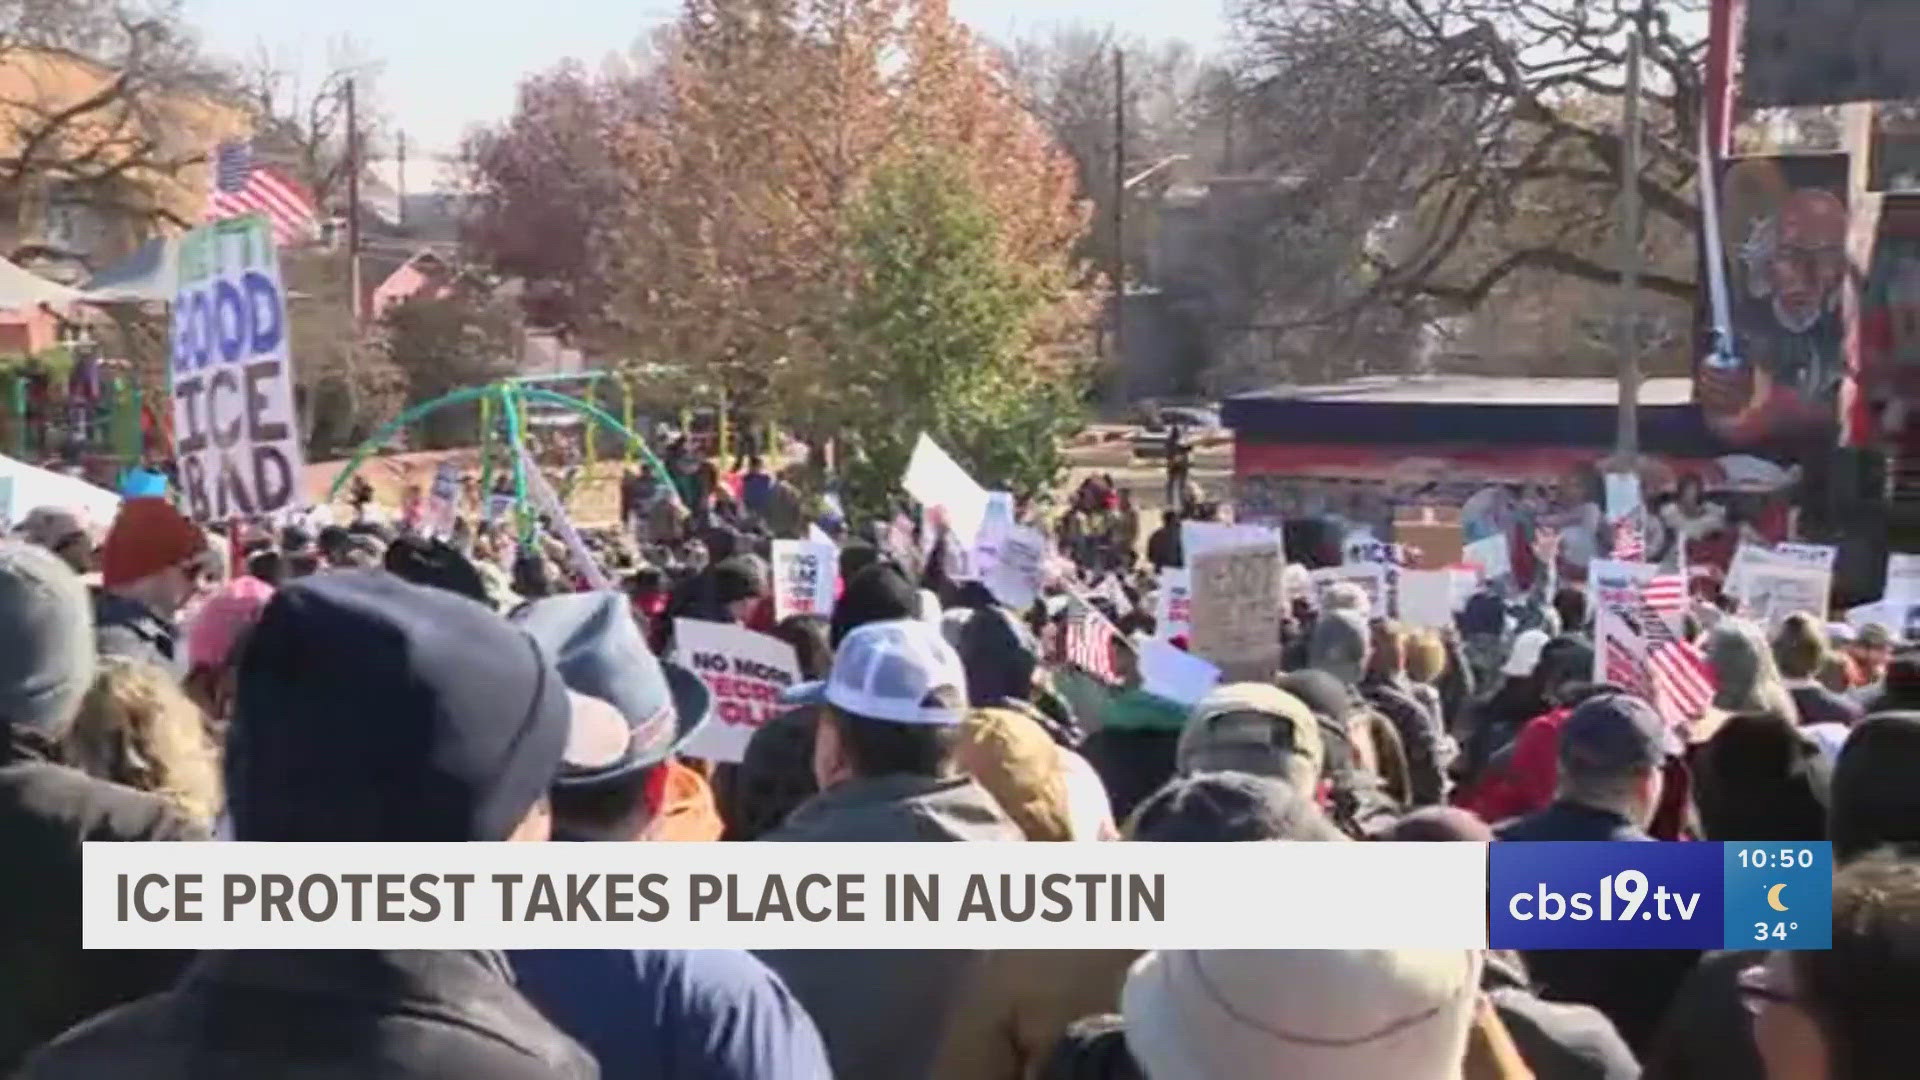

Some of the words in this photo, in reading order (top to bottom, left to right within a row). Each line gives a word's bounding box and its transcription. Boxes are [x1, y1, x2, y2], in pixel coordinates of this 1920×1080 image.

[176, 361, 288, 455] ICE
[181, 446, 292, 523] BAD
[692, 652, 728, 672] NO
[734, 658, 793, 686] MORE
